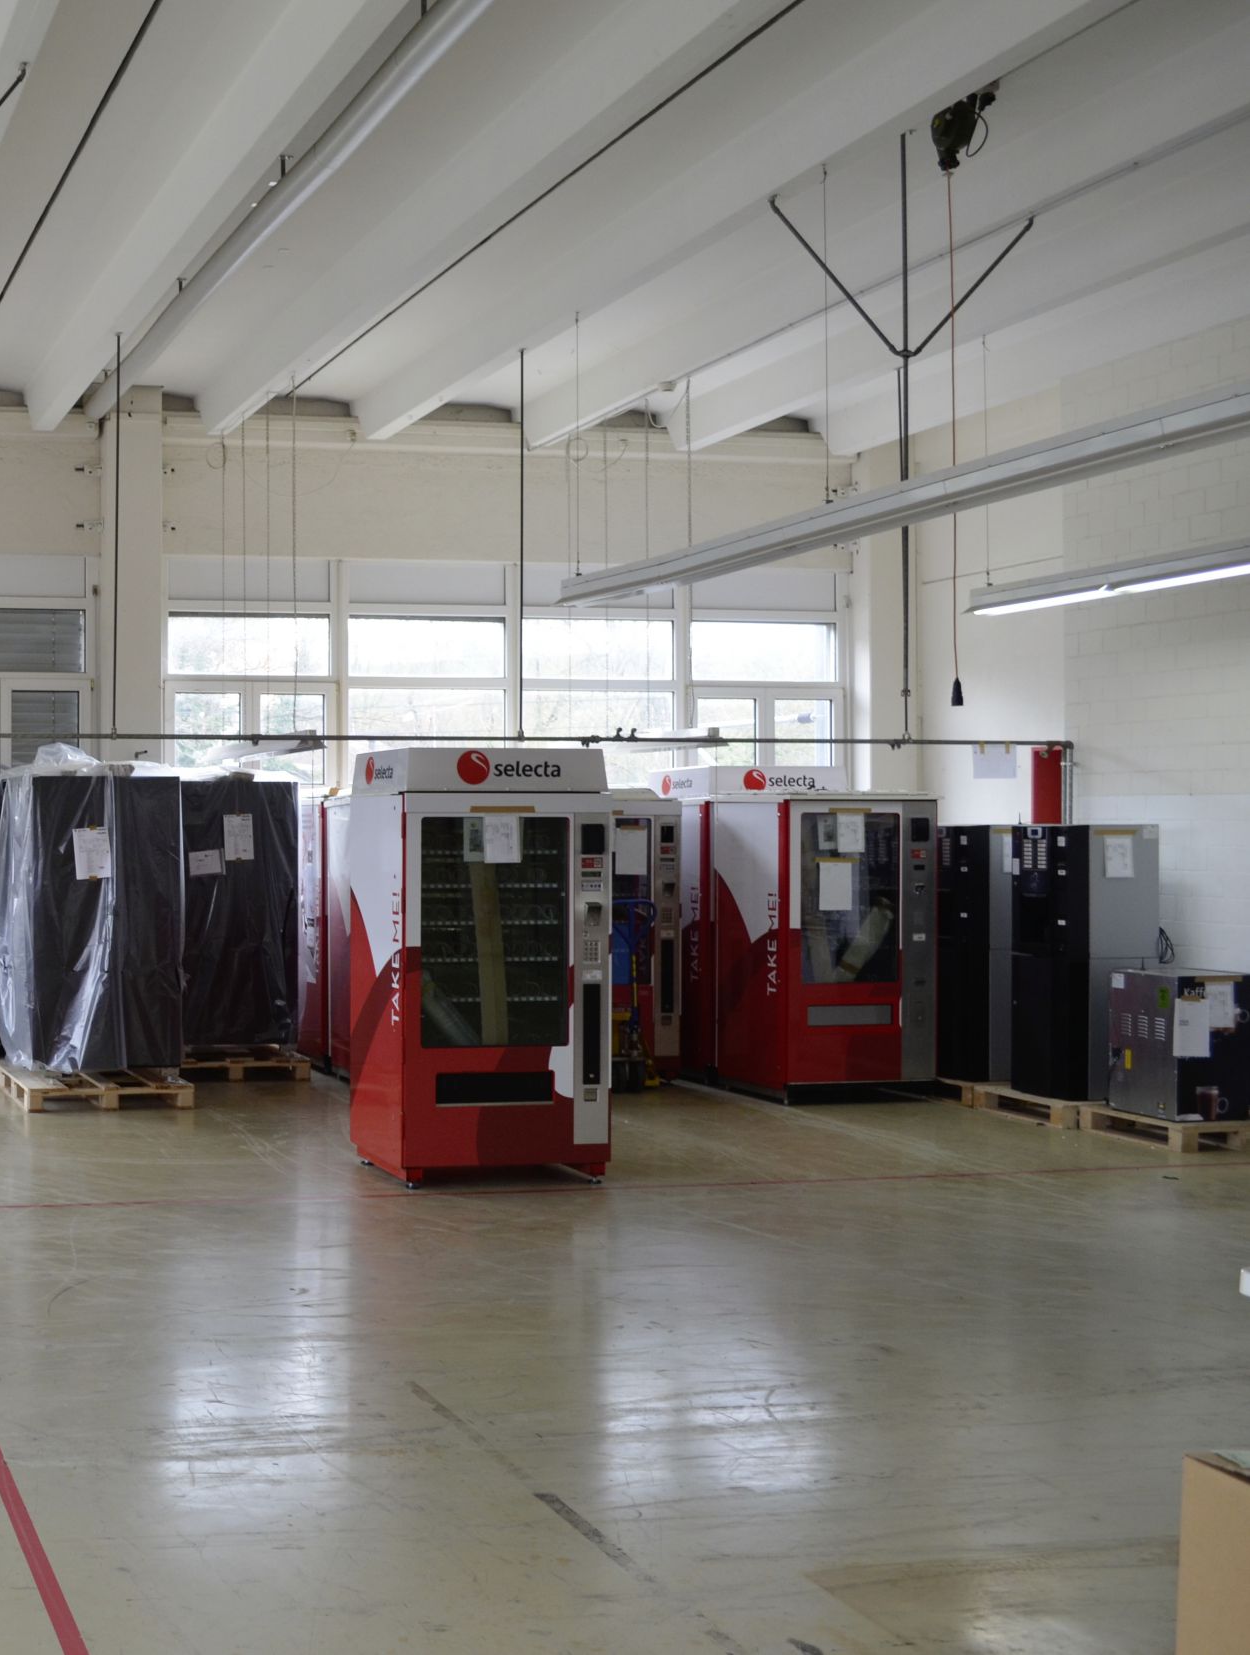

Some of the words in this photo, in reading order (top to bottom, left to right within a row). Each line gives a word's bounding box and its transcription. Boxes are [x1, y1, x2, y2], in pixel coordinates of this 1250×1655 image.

[374, 765, 394, 780] selecta
[493, 761, 561, 777] selecta
[672, 778, 693, 790] selecta
[768, 775, 816, 789] selecta
[392, 892, 400, 943] ME!
[690, 886, 699, 922] ME!
[768, 893, 777, 930] ME!
[690, 929, 699, 982] TAKE
[767, 939, 777, 996] TAKE
[391, 954, 400, 1026] TAKE
